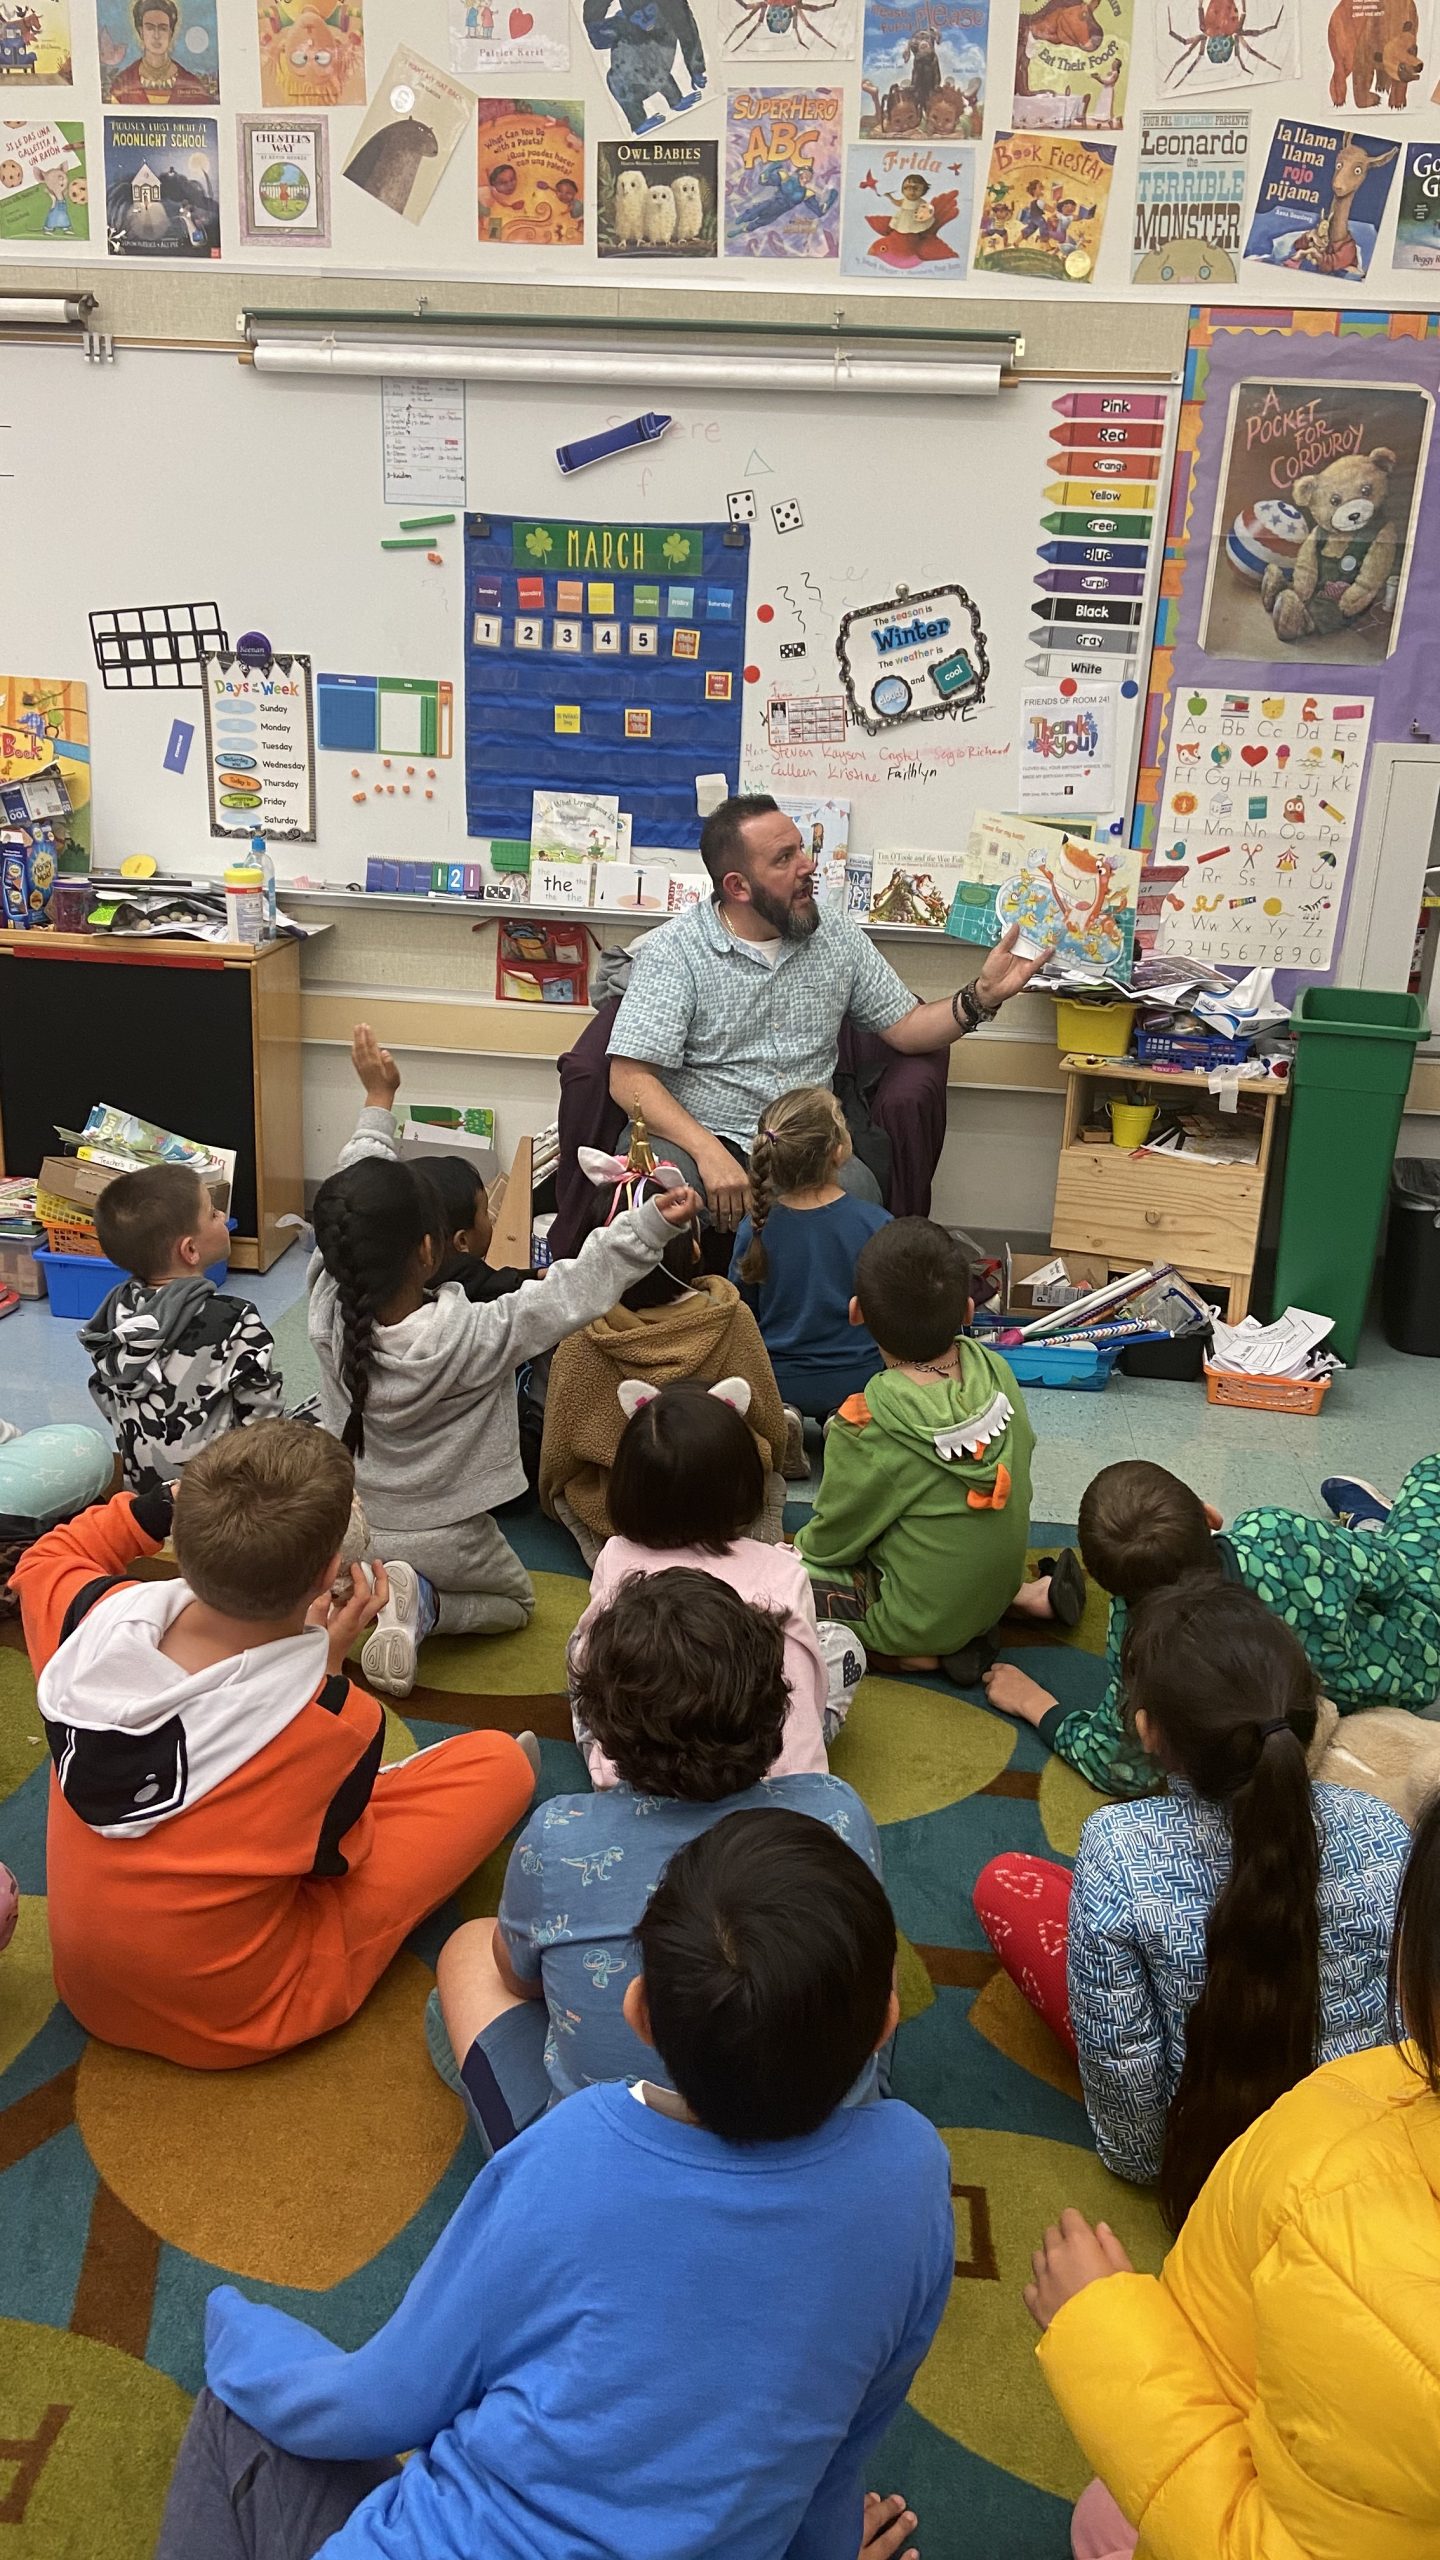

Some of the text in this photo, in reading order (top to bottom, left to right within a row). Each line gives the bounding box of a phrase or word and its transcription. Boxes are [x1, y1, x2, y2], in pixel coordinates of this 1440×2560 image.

[1038, 48, 1056, 66] Eat
[1057, 57, 1086, 71] Their
[733, 94, 839, 121] SUPERHERO
[1215, 115, 1249, 125] PRESENTS
[23, 132, 36, 145] DAS
[36, 125, 51, 139] UNA
[112, 133, 208, 148] MOONLIGHT SCHOOL
[255, 134, 311, 145] CHESTER'S
[505, 130, 519, 138] Can
[521, 127, 534, 136] You
[1141, 130, 1248, 155] Leonardo
[1277, 124, 1337, 151] la llama
[18, 138, 51, 158] GALLETITA
[271, 143, 295, 153] WAY
[617, 145, 701, 160] OWL BABIES
[743, 121, 821, 170] ABC
[1282, 144, 1325, 167] llama
[28, 157, 39, 167] UN
[882, 150, 942, 173] Frida
[1186, 157, 1198, 167] the
[1282, 165, 1314, 185] rojo
[1138, 170, 1245, 202] TERRIBLE
[1266, 180, 1320, 204] pijama
[1134, 203, 1241, 250] MONSTER
[1101, 399, 1130, 413] Pink
[1262, 387, 1280, 416] A
[1246, 398, 1322, 450] POCKET
[1099, 428, 1127, 443] Red
[1294, 419, 1333, 450] FOR
[1270, 423, 1364, 489] CORDUROY
[1093, 460, 1127, 474] Orange
[1090, 490, 1121, 502] Yellow
[567, 529, 645, 570] MARCH
[1083, 548, 1113, 562] Blue
[874, 605, 933, 627] The season is
[1075, 604, 1109, 618] Black
[484, 623, 649, 647] 1 2 3 4 5
[872, 619, 949, 653] Winter
[1075, 634, 1104, 649] Gray
[878, 646, 943, 670] The weather is
[1071, 662, 1102, 675] White
[214, 679, 300, 699] Days Week
[877, 665, 963, 706] cloudy and cool
[259, 704, 288, 714] Sunday
[1024, 697, 1058, 706] FRIENDS
[1059, 697, 1070, 705] OF
[1072, 696, 1096, 704] ROOM
[261, 723, 291, 733] Monday
[1030, 714, 1090, 740] Thank
[1180, 716, 1357, 742] Aa Bb Cc Dd Ee
[1, 732, 43, 761] Book
[261, 742, 293, 751] Tuesday
[262, 761, 306, 771] Wednesday
[263, 779, 299, 789] Thursday
[1174, 767, 1197, 783] Ff
[1205, 769, 1231, 792] Gg
[1238, 770, 1262, 787] Hh
[1272, 771, 1289, 789] Ii
[1299, 773, 1320, 798] Jj
[263, 798, 287, 807] Friday
[264, 816, 299, 825] Saturday
[1110, 817, 1124, 836] d
[1173, 818, 1341, 845] Ll Mm Nn Oo Pp
[544, 875, 573, 892] the
[1201, 867, 1222, 884] Rr
[1239, 870, 1256, 887] Ss
[1309, 873, 1333, 890] Uu
[567, 892, 582, 902] the
[667, 880, 676, 911] TARDY
[1191, 915, 1323, 941] Ww Xx Yy Zz
[1165, 939, 1322, 964] 2 3 4 5 6 7 8 9 0
